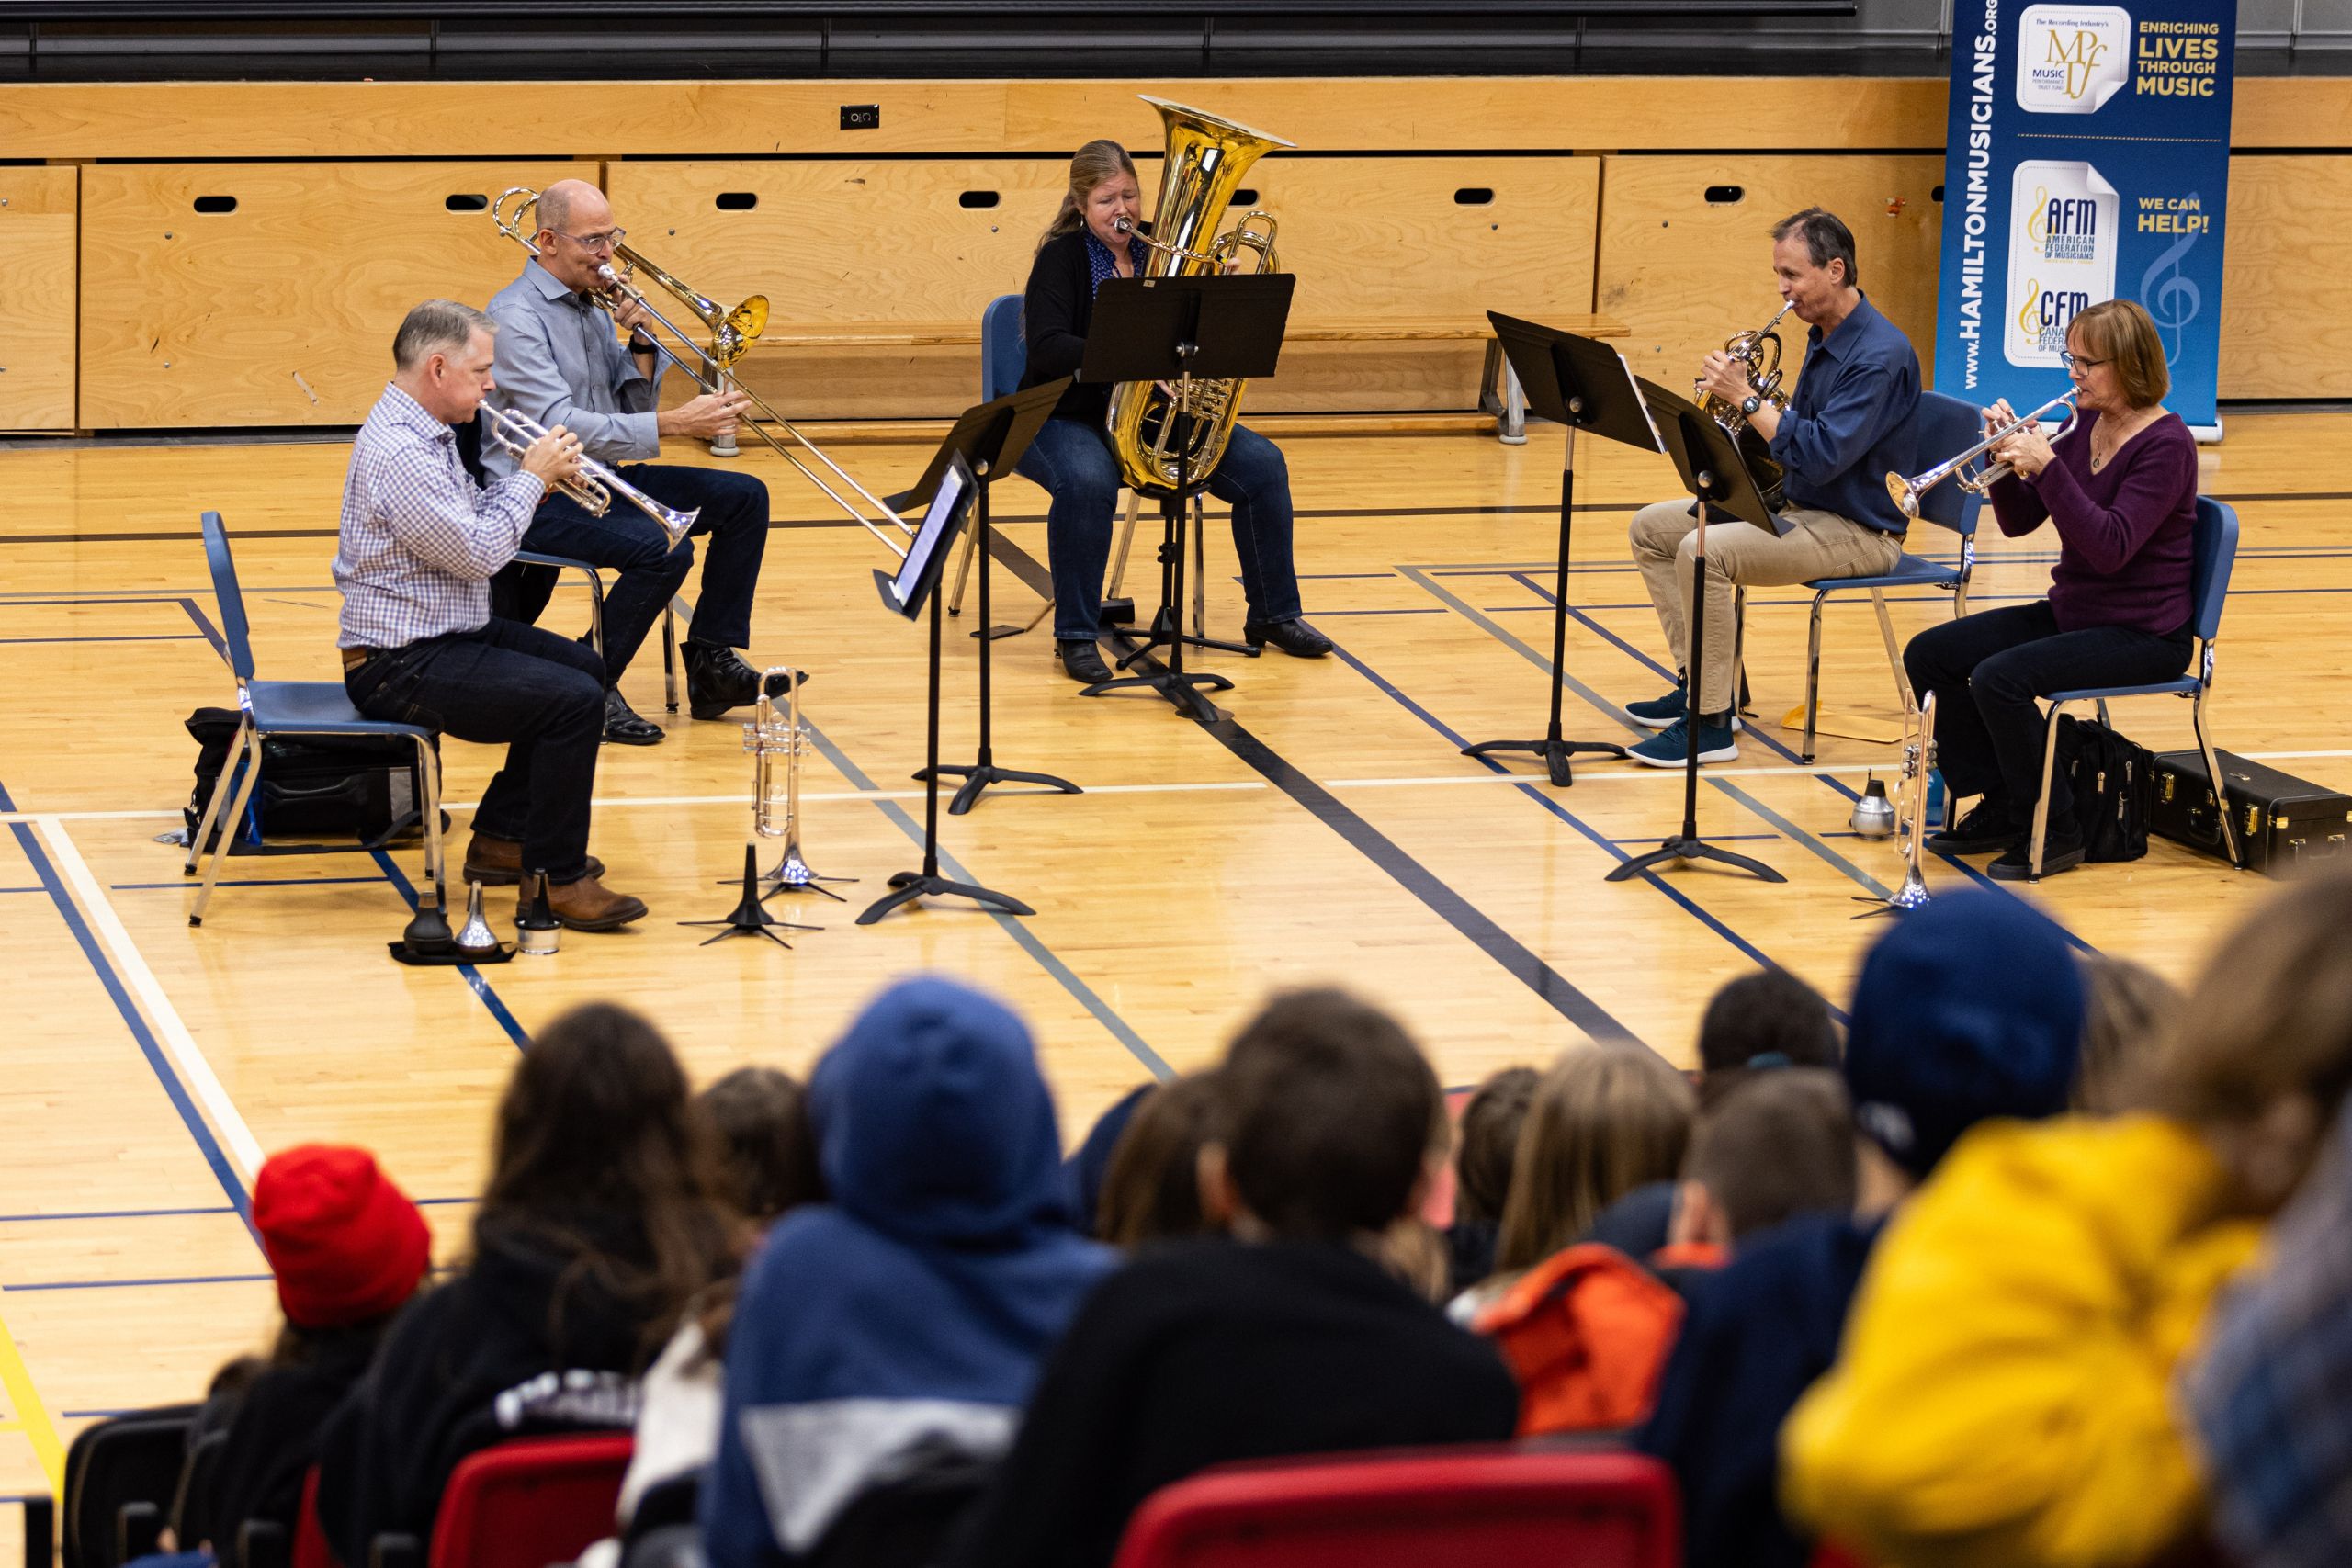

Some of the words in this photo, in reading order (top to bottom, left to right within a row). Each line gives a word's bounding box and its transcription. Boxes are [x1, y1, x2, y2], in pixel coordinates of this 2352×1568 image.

[2048, 19, 2078, 28] Recording
[2139, 21, 2220, 35] ENRICHING
[2138, 38, 2219, 60] LIVES
[2032, 69, 2065, 79] MUSIC
[2137, 60, 2216, 74] THROUGH
[2136, 76, 2215, 97] MUSIC
[1960, 0, 1998, 389] www.HAMILTONMUSICIANS.ORG
[2138, 197, 2164, 210] WE
[2167, 198, 2200, 211] CAN
[2046, 197, 2096, 234] AFM
[2137, 214, 2209, 234] HELP!
[2046, 235, 2095, 244] AMERICAN
[2045, 243, 2095, 253] FEDERATION
[2054, 252, 2094, 260] MUSICIANS
